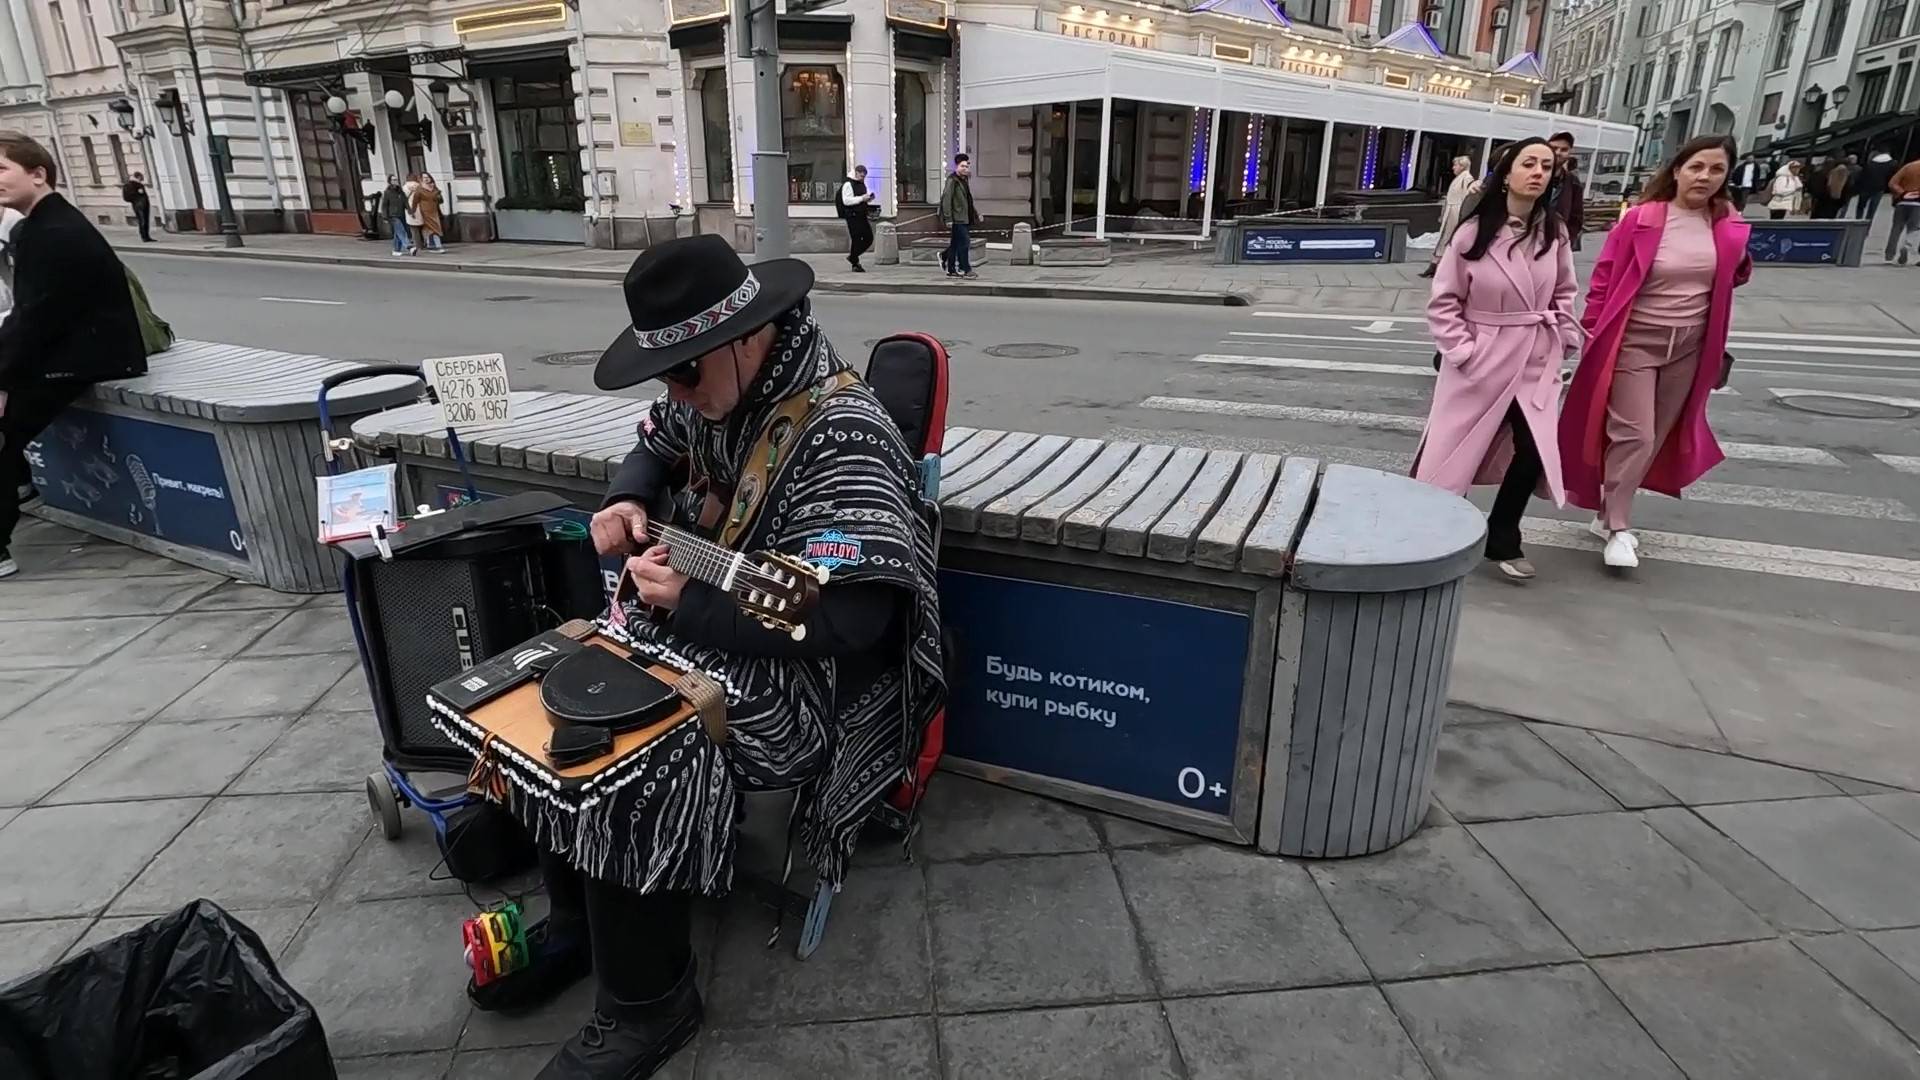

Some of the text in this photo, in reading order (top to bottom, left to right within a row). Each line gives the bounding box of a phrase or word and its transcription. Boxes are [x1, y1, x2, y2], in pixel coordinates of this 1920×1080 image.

[435, 358, 502, 377] СБЕРБАНК
[441, 375, 507, 399] 4276 3800
[445, 399, 508, 423] 3206 1967
[452, 607, 474, 672] CUB
[986, 655, 1151, 704] Будь котиком,
[986, 689, 1117, 728] купи рыбку
[1177, 766, 1228, 799] 0+
